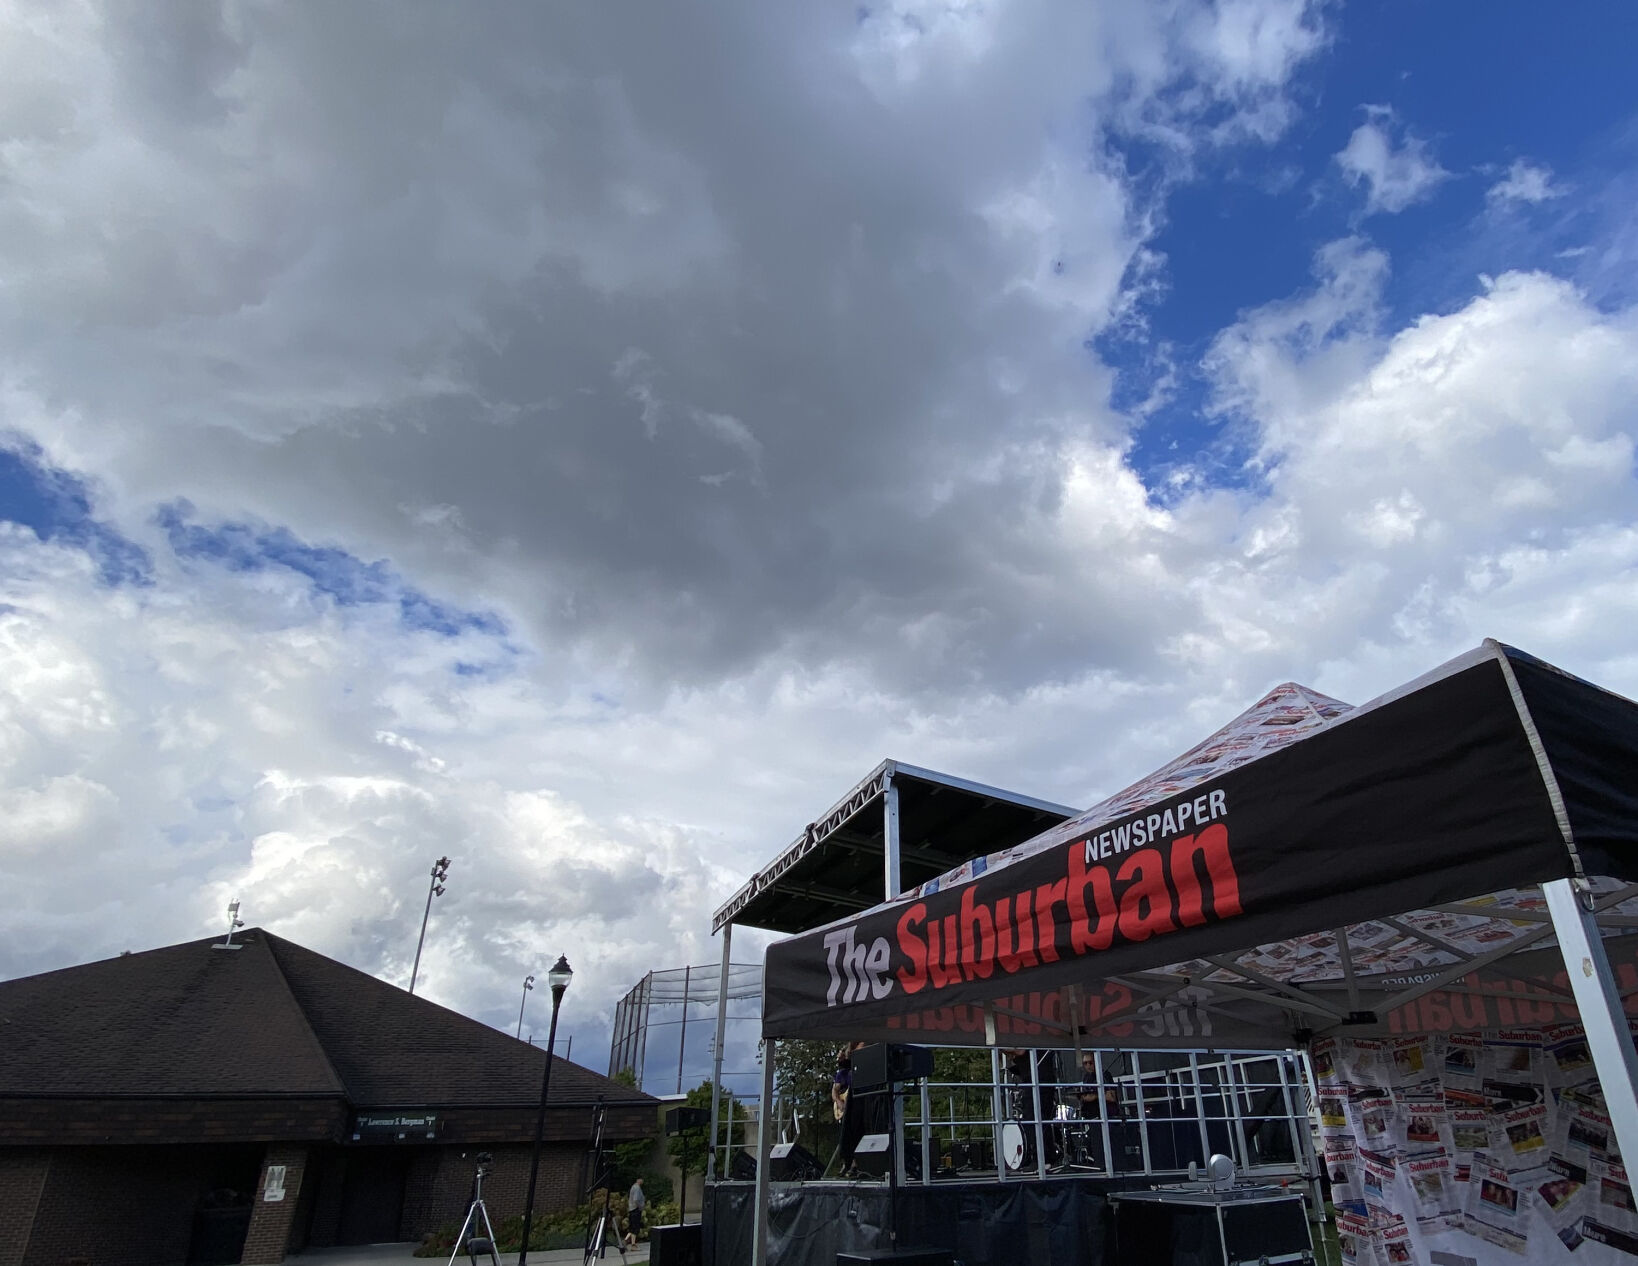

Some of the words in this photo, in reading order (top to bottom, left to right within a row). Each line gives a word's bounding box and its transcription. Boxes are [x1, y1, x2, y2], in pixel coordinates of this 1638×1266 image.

[1084, 789, 1228, 863] NEWSPAPER
[823, 925, 894, 1007] The
[896, 822, 1244, 995] Suburban
[1353, 1040, 1382, 1051] Suburba
[1449, 1035, 1483, 1048] Suburba
